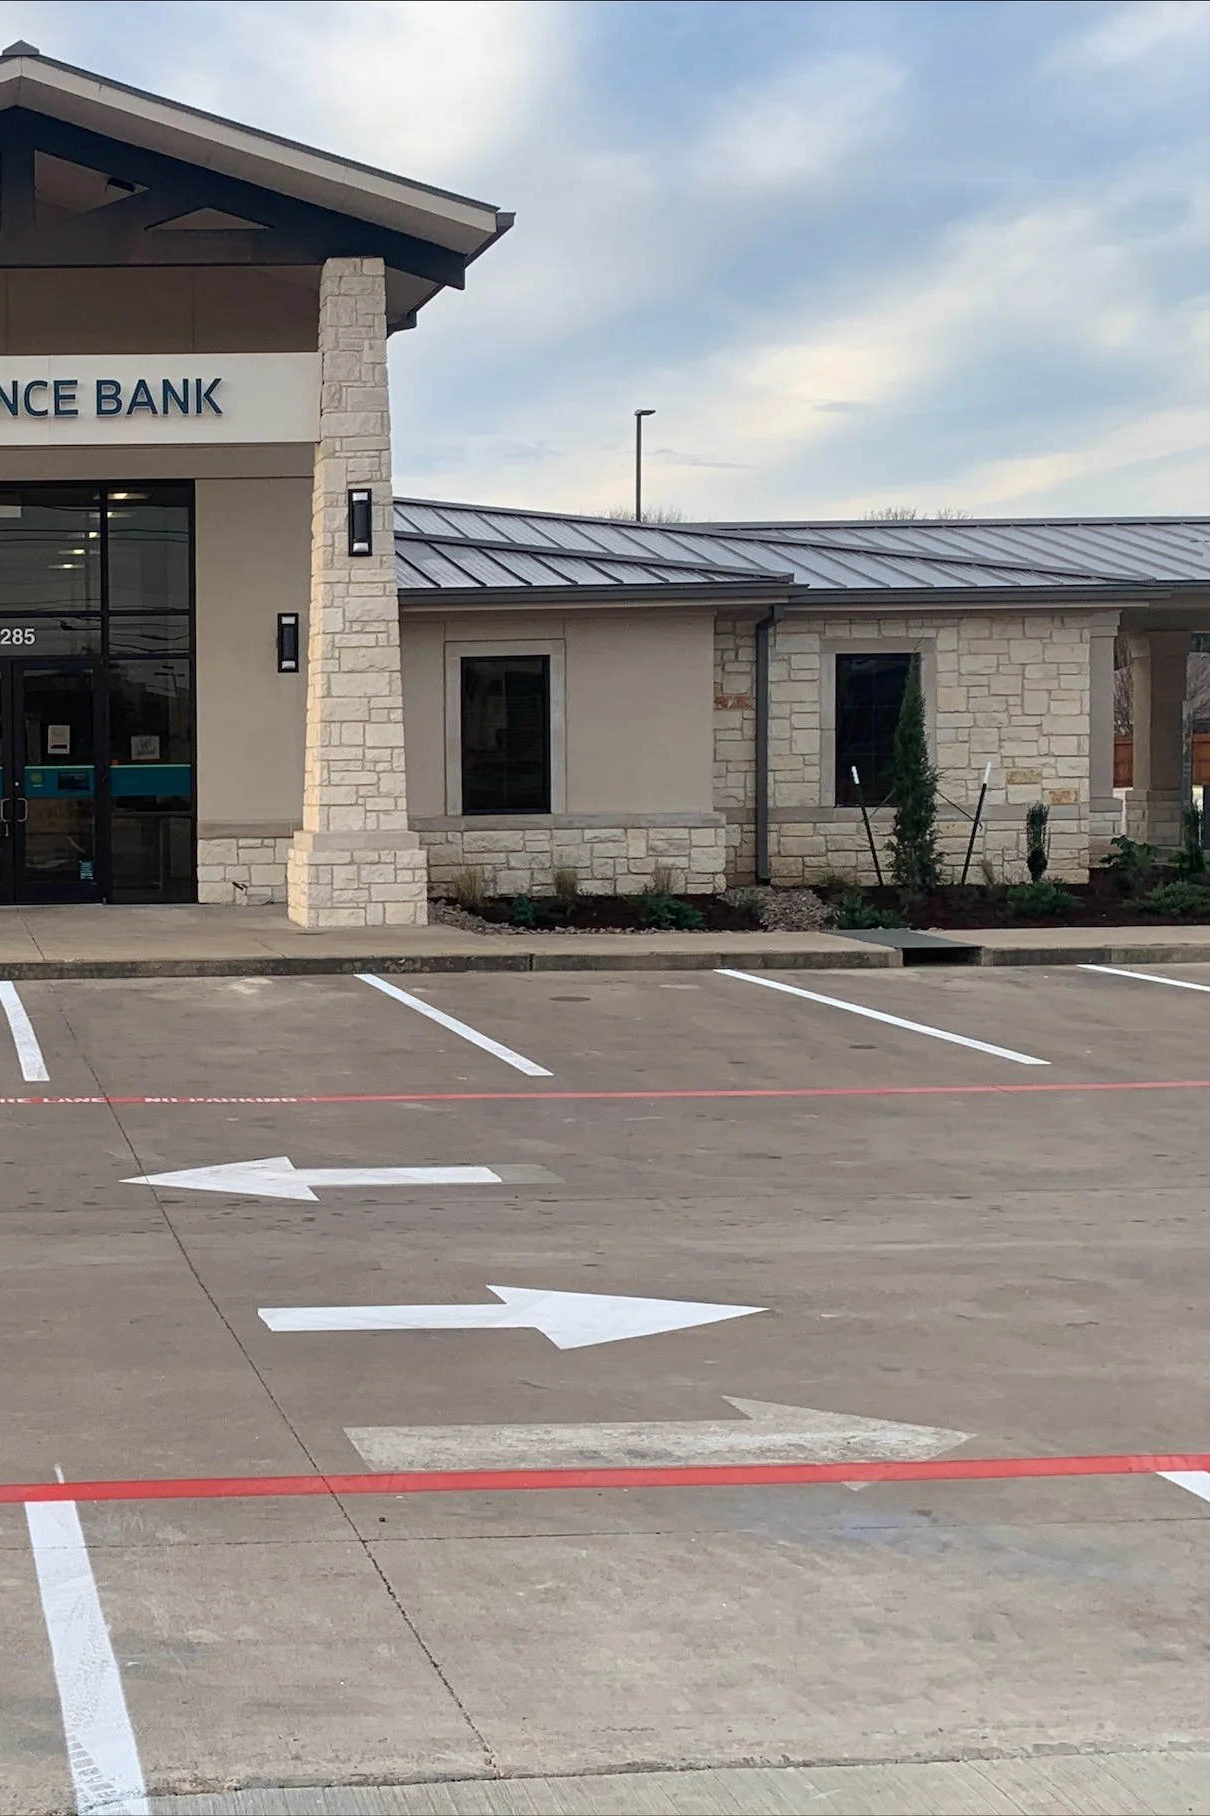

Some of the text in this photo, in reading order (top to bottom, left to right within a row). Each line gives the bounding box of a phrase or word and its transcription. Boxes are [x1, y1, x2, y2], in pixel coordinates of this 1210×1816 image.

[95, 377, 223, 416] BANK
[42, 1096, 107, 1104] LANE
[144, 1096, 179, 1104] NO
[189, 1096, 298, 1104] PARKING
